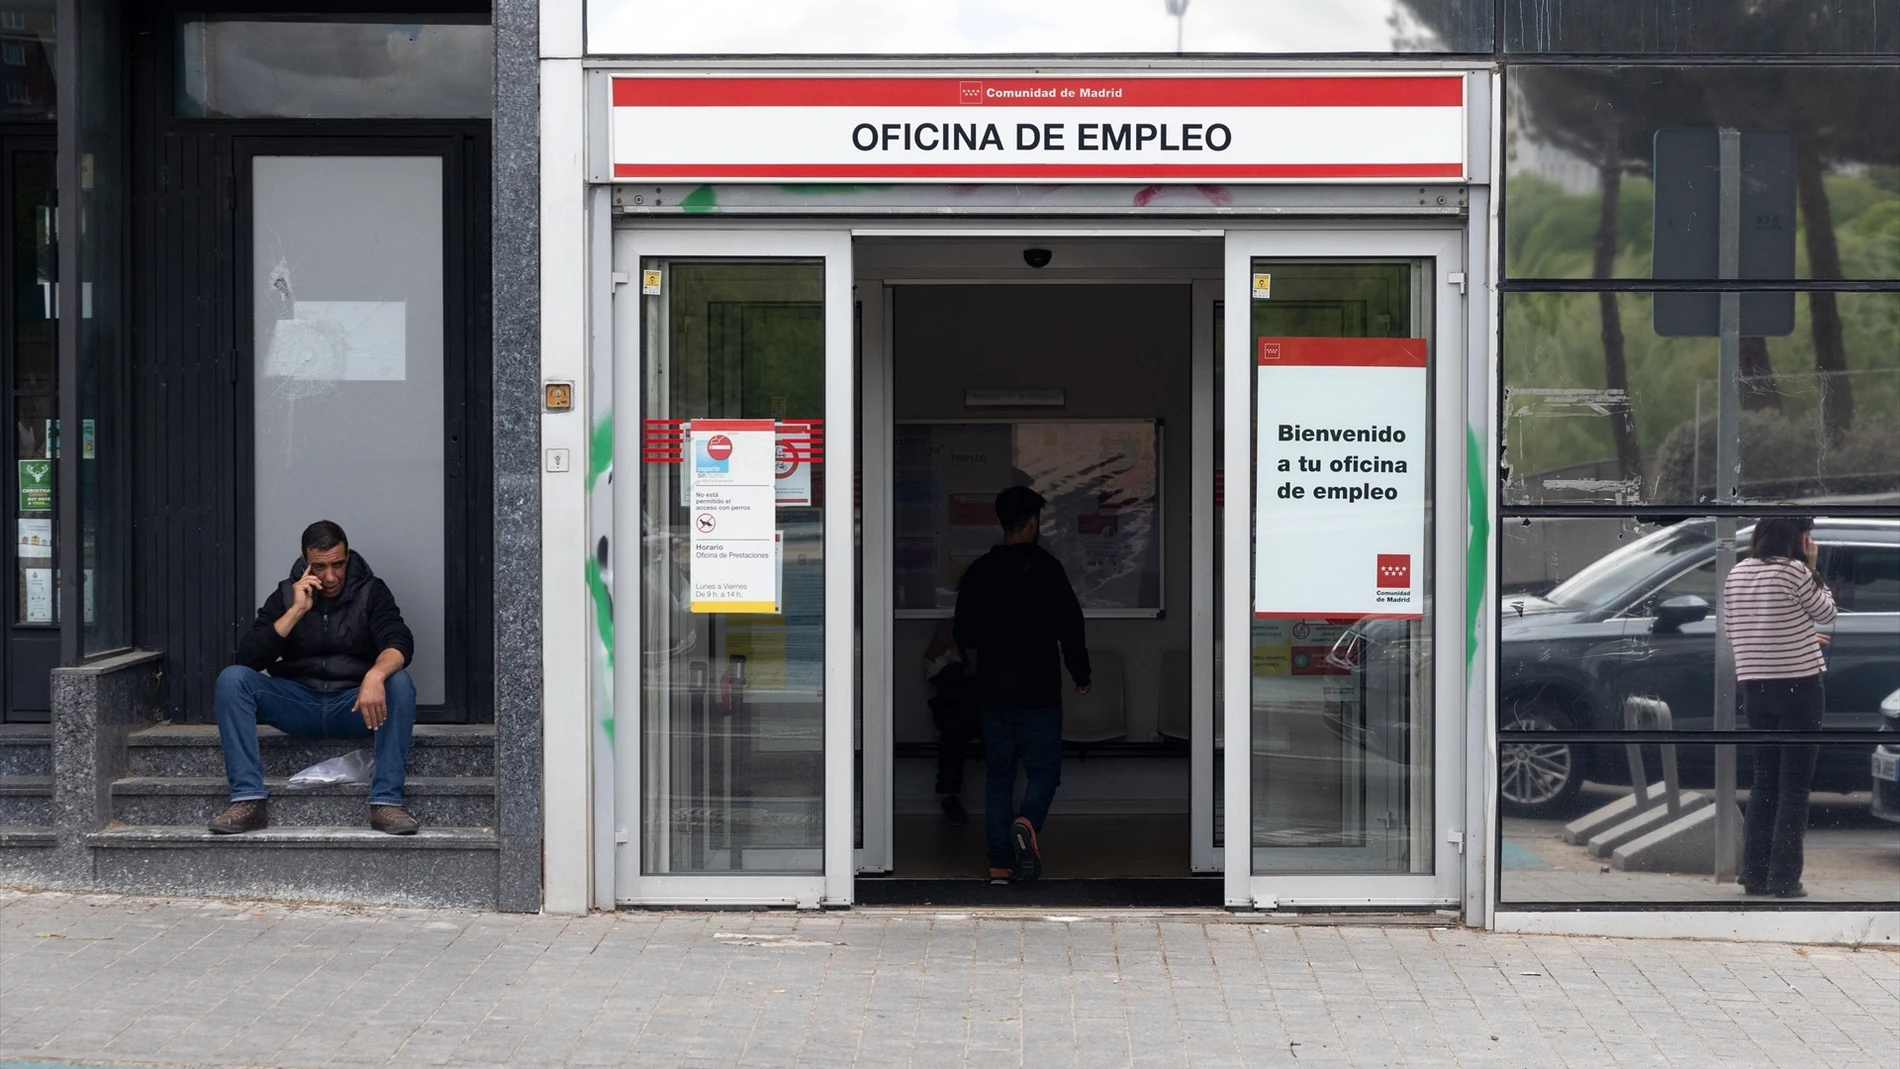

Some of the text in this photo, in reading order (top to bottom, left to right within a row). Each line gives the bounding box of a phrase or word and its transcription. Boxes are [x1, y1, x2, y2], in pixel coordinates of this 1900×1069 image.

[986, 87, 1123, 98] Comunidad de Madrid
[852, 122, 1232, 151] OFICINA DE EMPLEO
[1278, 424, 1407, 444] Bienvenido
[1277, 455, 1408, 474] a tu oficina
[1277, 481, 1398, 504] de empleo
[696, 543, 724, 551] Horario
[696, 551, 769, 559] Oficina de Prestaciones
[723, 582, 748, 590] Viernes
